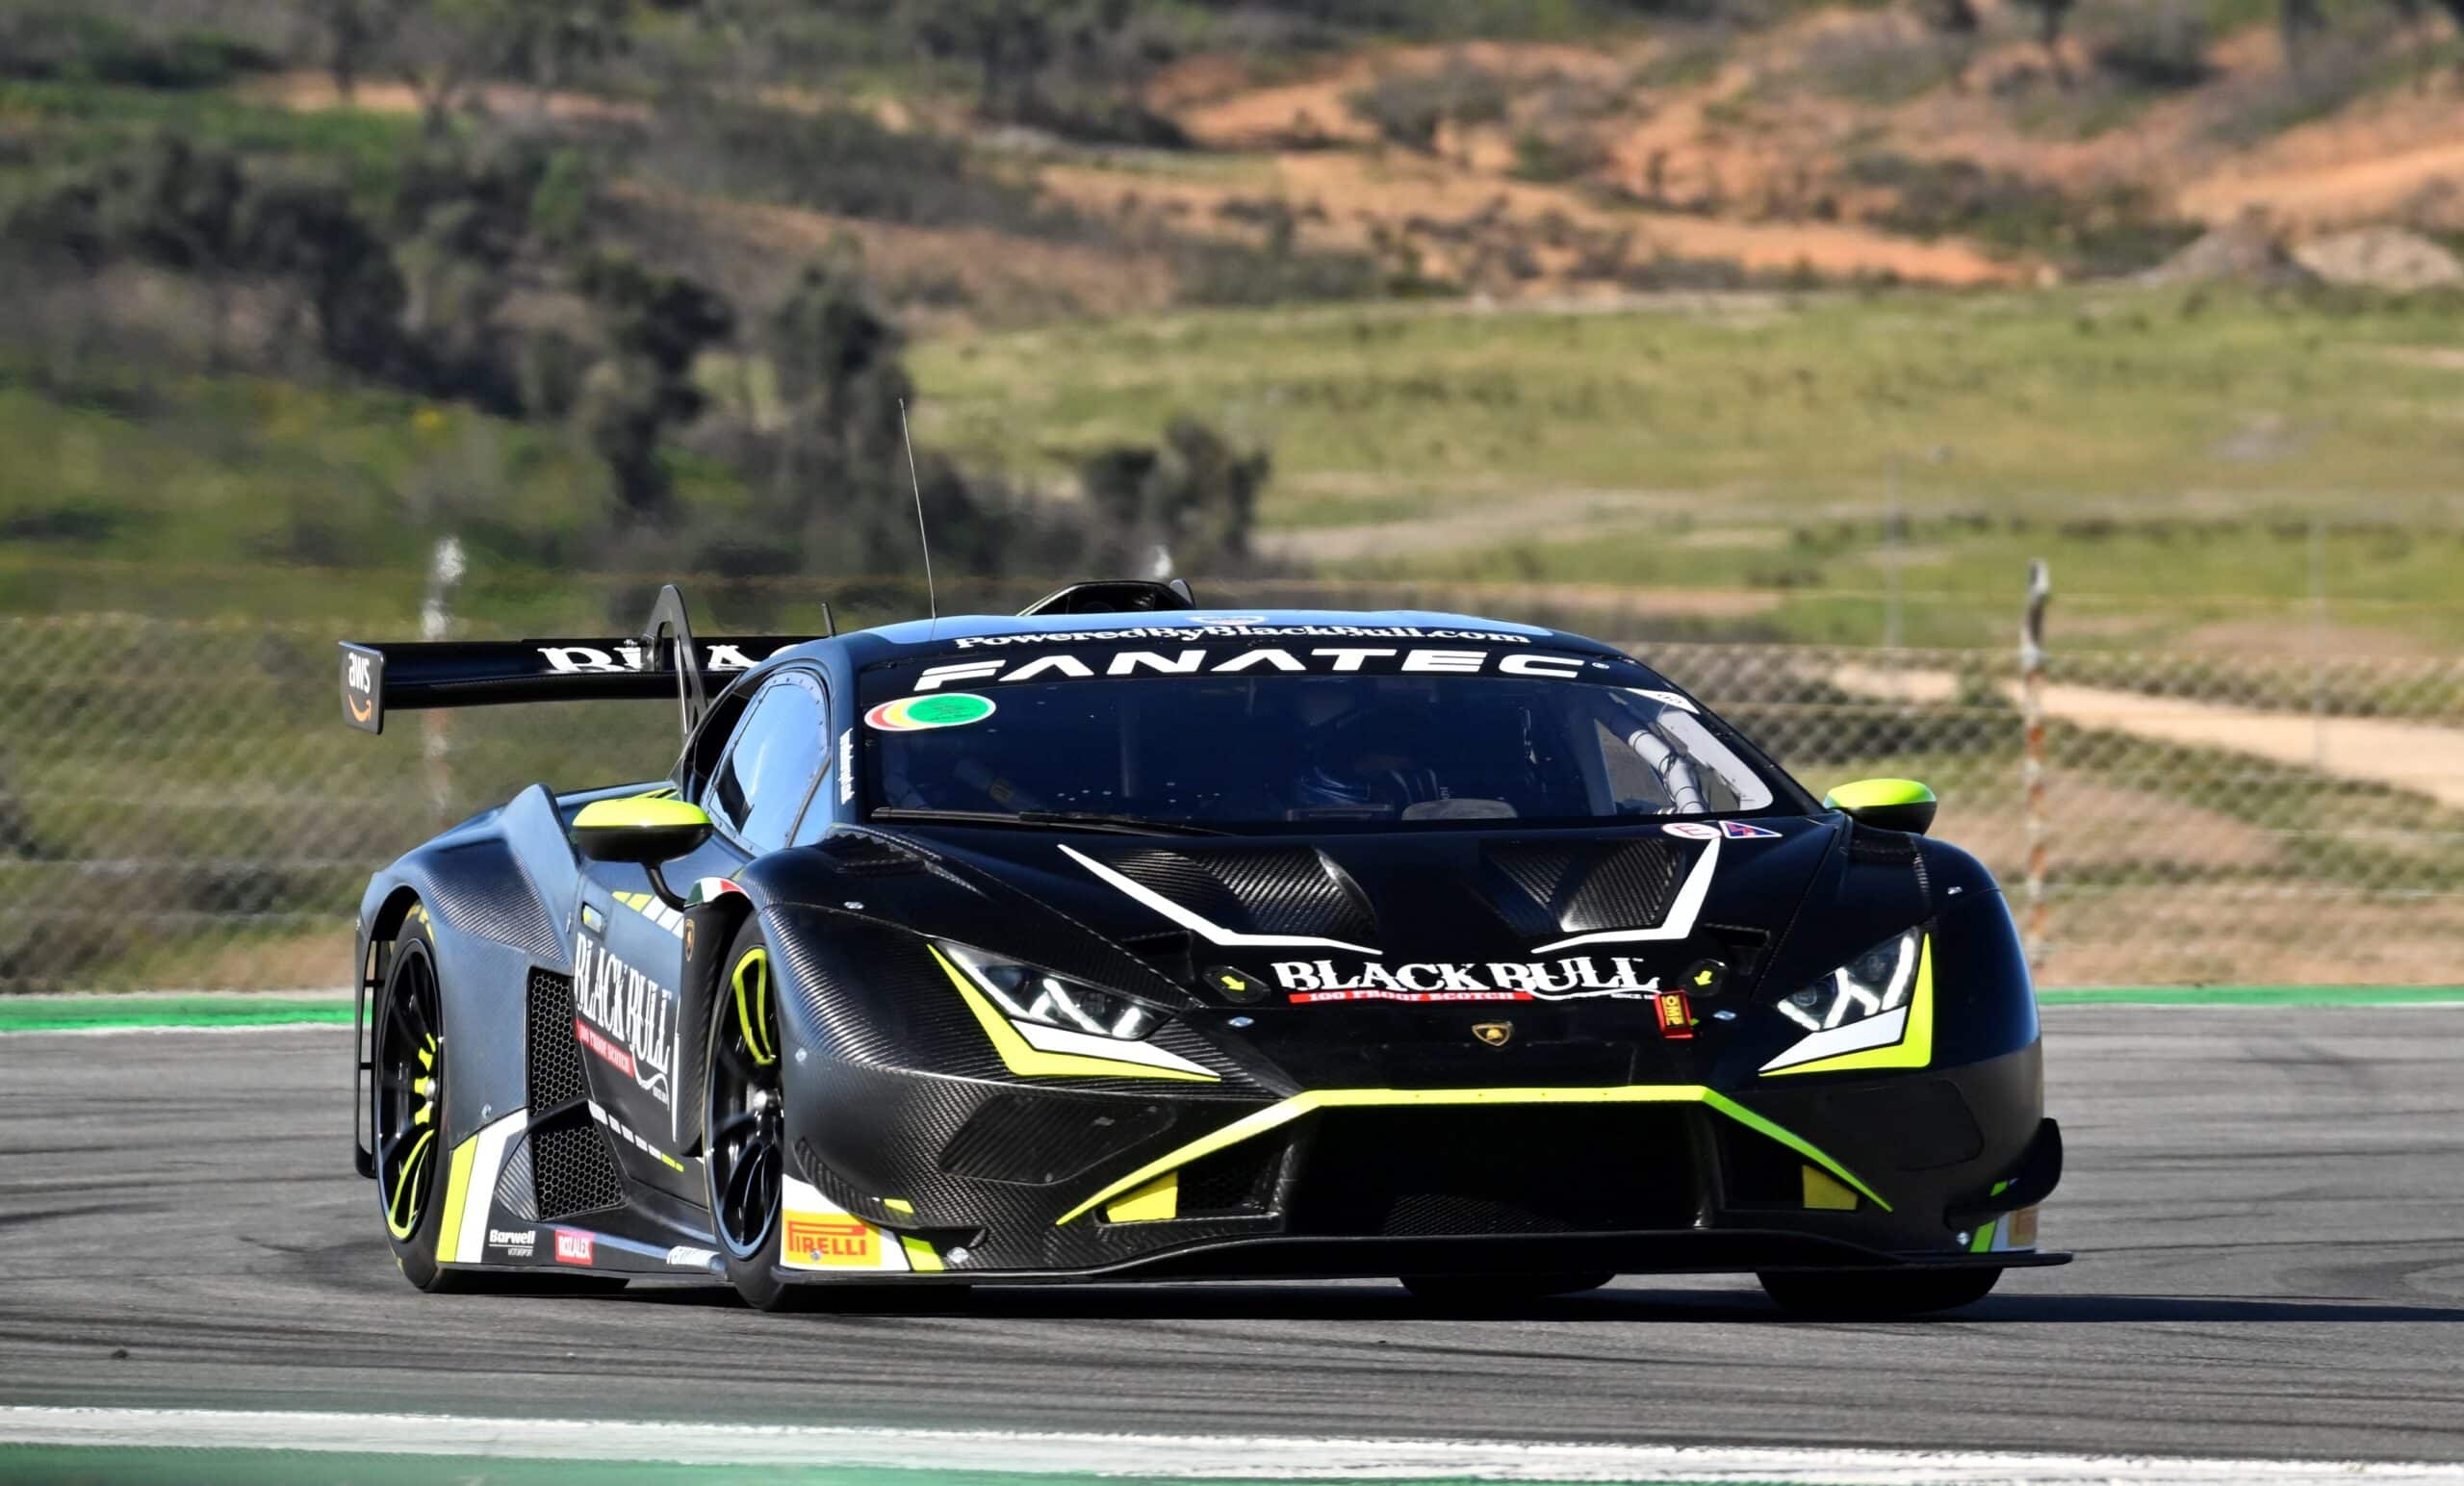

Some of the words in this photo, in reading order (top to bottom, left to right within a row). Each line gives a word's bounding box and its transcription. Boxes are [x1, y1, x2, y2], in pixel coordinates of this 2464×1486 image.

[954, 625, 1531, 649] PoweredByBlackBull.com
[348, 652, 371, 694] aws
[913, 649, 1585, 691] FANATEC
[1270, 960, 1491, 991] BLACK
[1486, 957, 1661, 995] BULL
[574, 932, 629, 1042] BLACK
[626, 967, 672, 1076] BULL
[1661, 995, 1684, 1026] OMP
[489, 1229, 536, 1244] Barwell
[788, 1220, 866, 1256] PIRELLI
